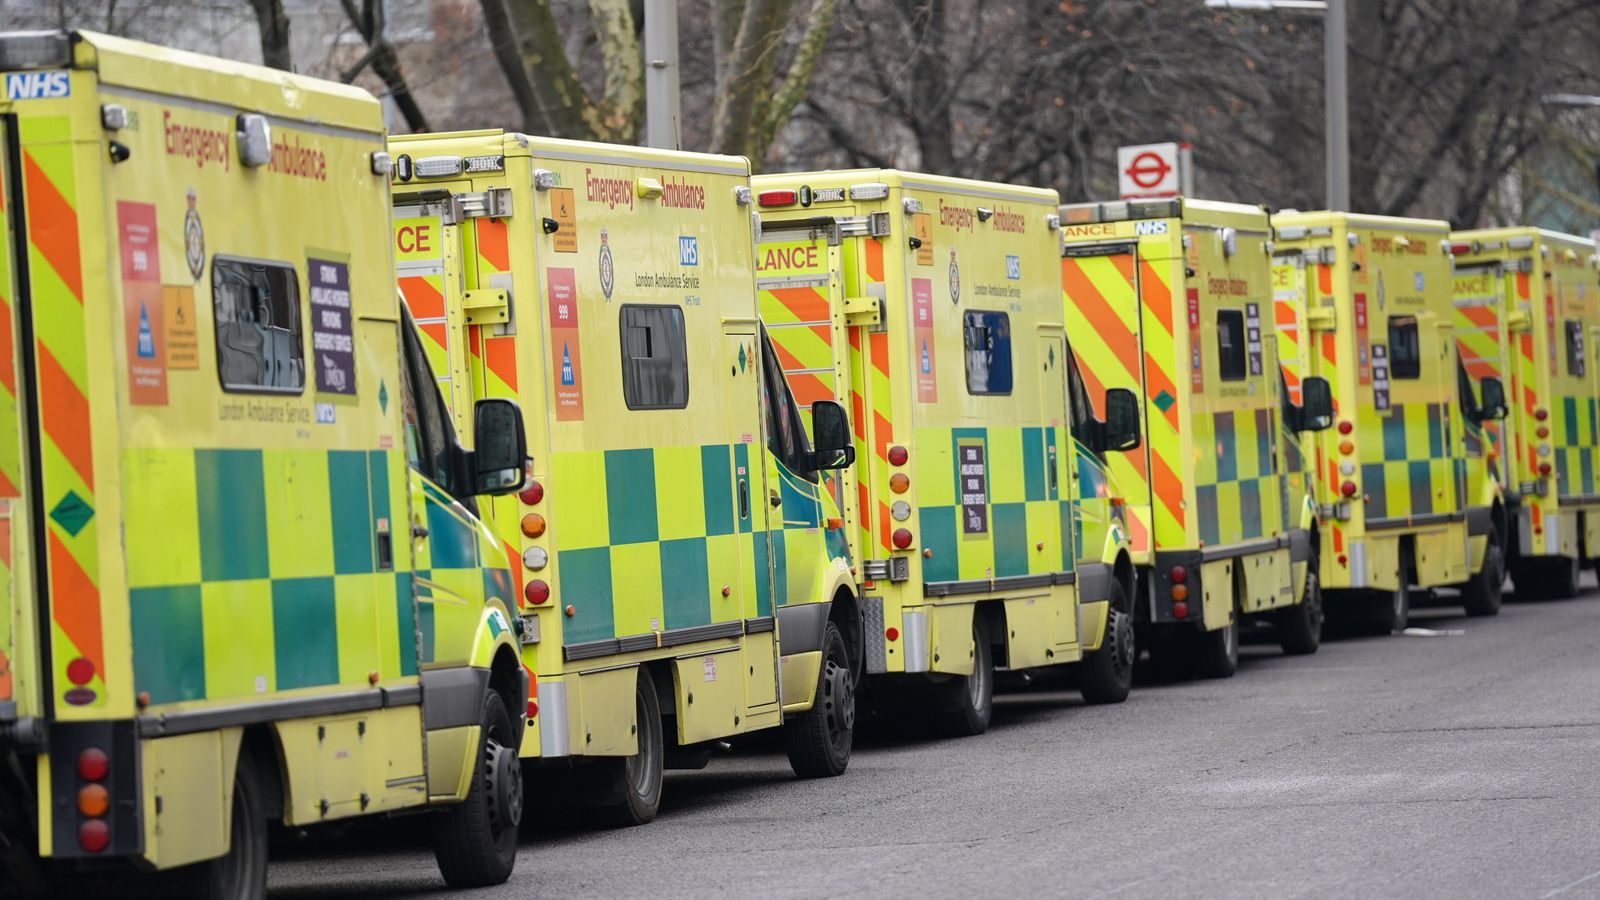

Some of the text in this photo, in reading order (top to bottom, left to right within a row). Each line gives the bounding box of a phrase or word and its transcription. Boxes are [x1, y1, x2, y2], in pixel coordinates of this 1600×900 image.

[8, 72, 69, 99] NHS
[163, 110, 230, 172] Emergency
[585, 168, 704, 211] Emergency Ambulance
[939, 198, 1025, 234] Emergency Ambulance
[1135, 221, 1167, 235] NHS
[394, 225, 431, 253] CE
[1065, 225, 1113, 237] ANCE
[680, 239, 697, 264] NHS
[635, 272, 700, 289] London Ambulance Service
[559, 304, 568, 320] 999
[563, 366, 572, 381] 111
